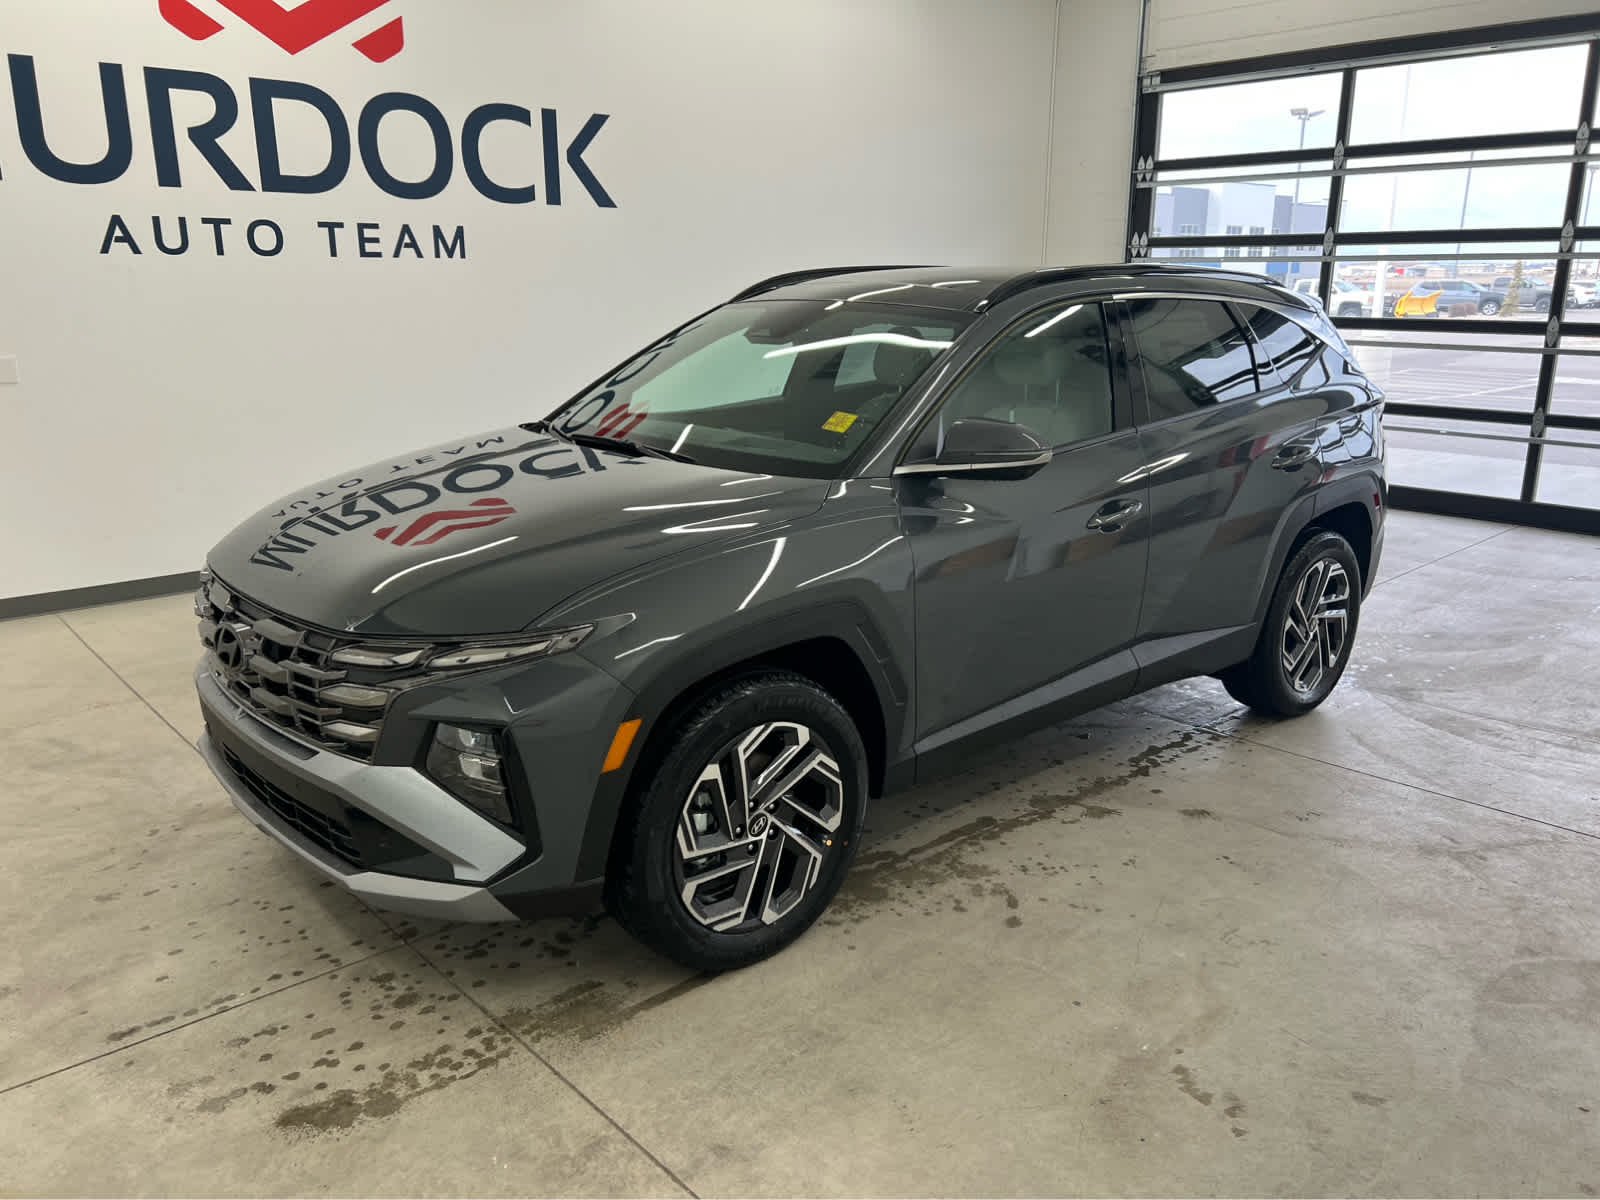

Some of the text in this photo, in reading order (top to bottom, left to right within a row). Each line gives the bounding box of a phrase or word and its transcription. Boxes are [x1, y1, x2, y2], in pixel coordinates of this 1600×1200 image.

[0, 53, 618, 208] URDOCK
[100, 214, 467, 259] AUTO TEAM
